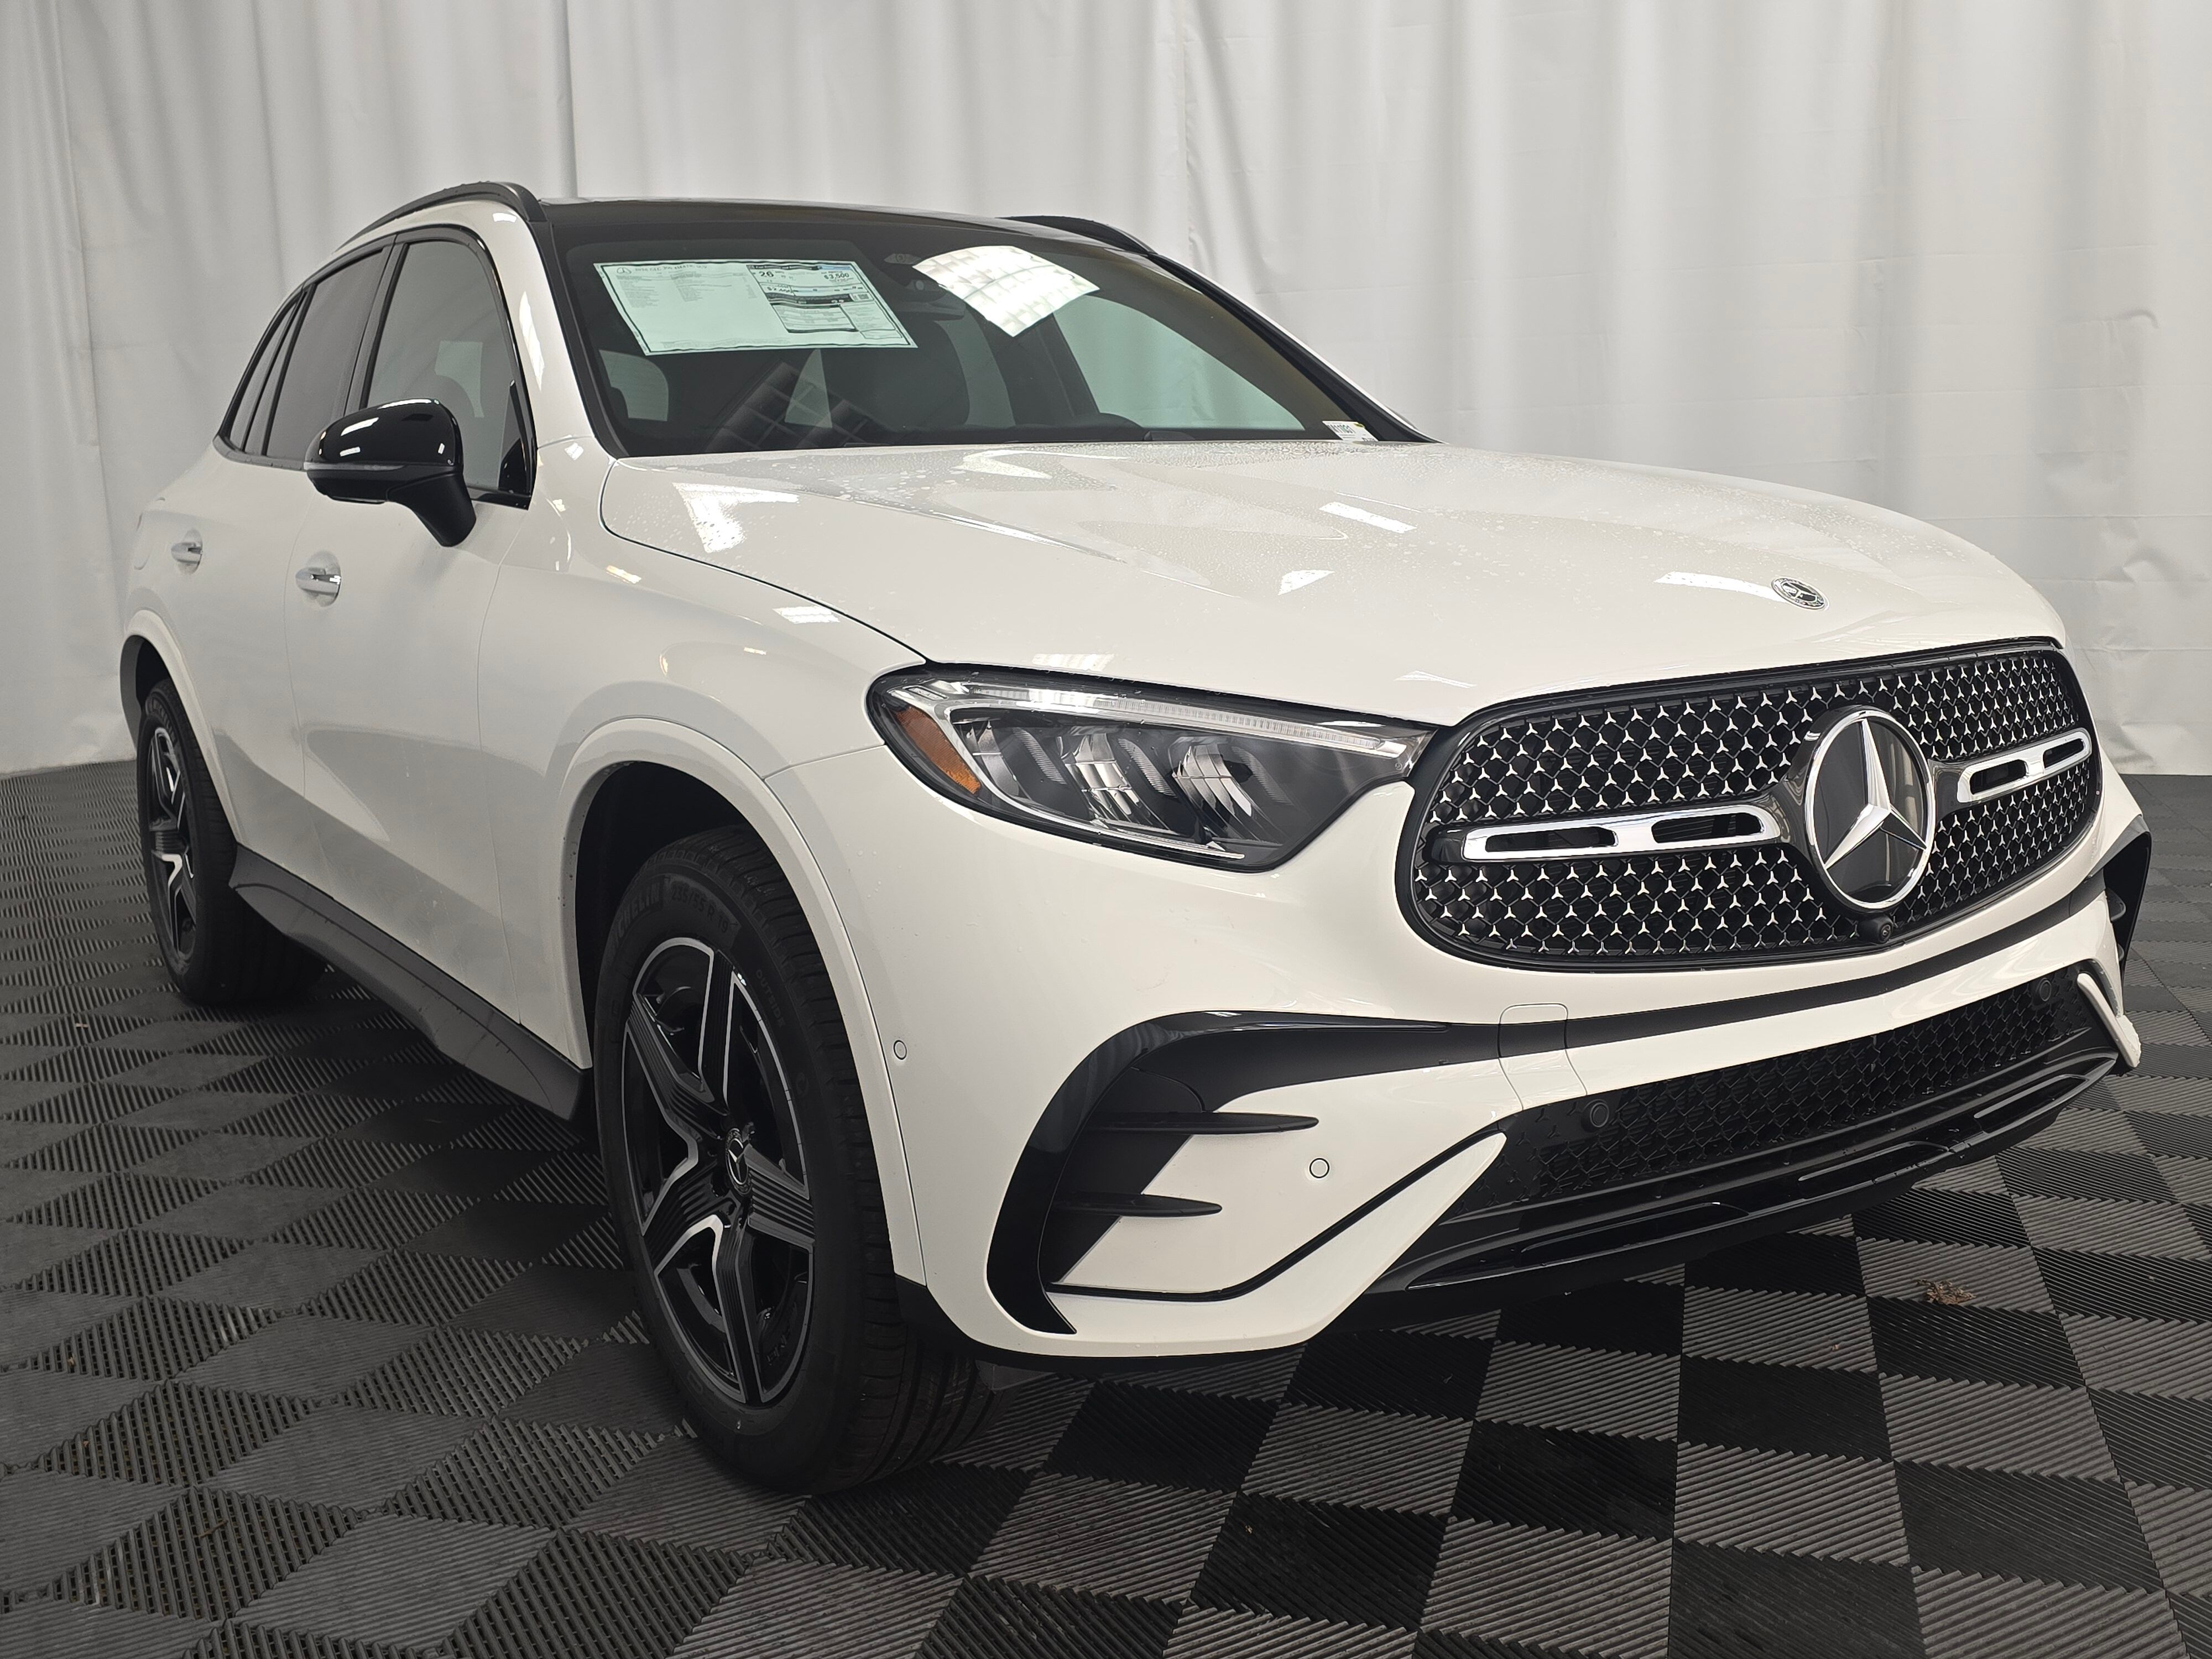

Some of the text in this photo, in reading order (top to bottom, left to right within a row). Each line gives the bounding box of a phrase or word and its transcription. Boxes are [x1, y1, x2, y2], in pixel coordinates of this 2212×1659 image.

[671, 881, 729, 933] 235/55 R 19
[755, 969, 786, 1028] OUTSIDE
